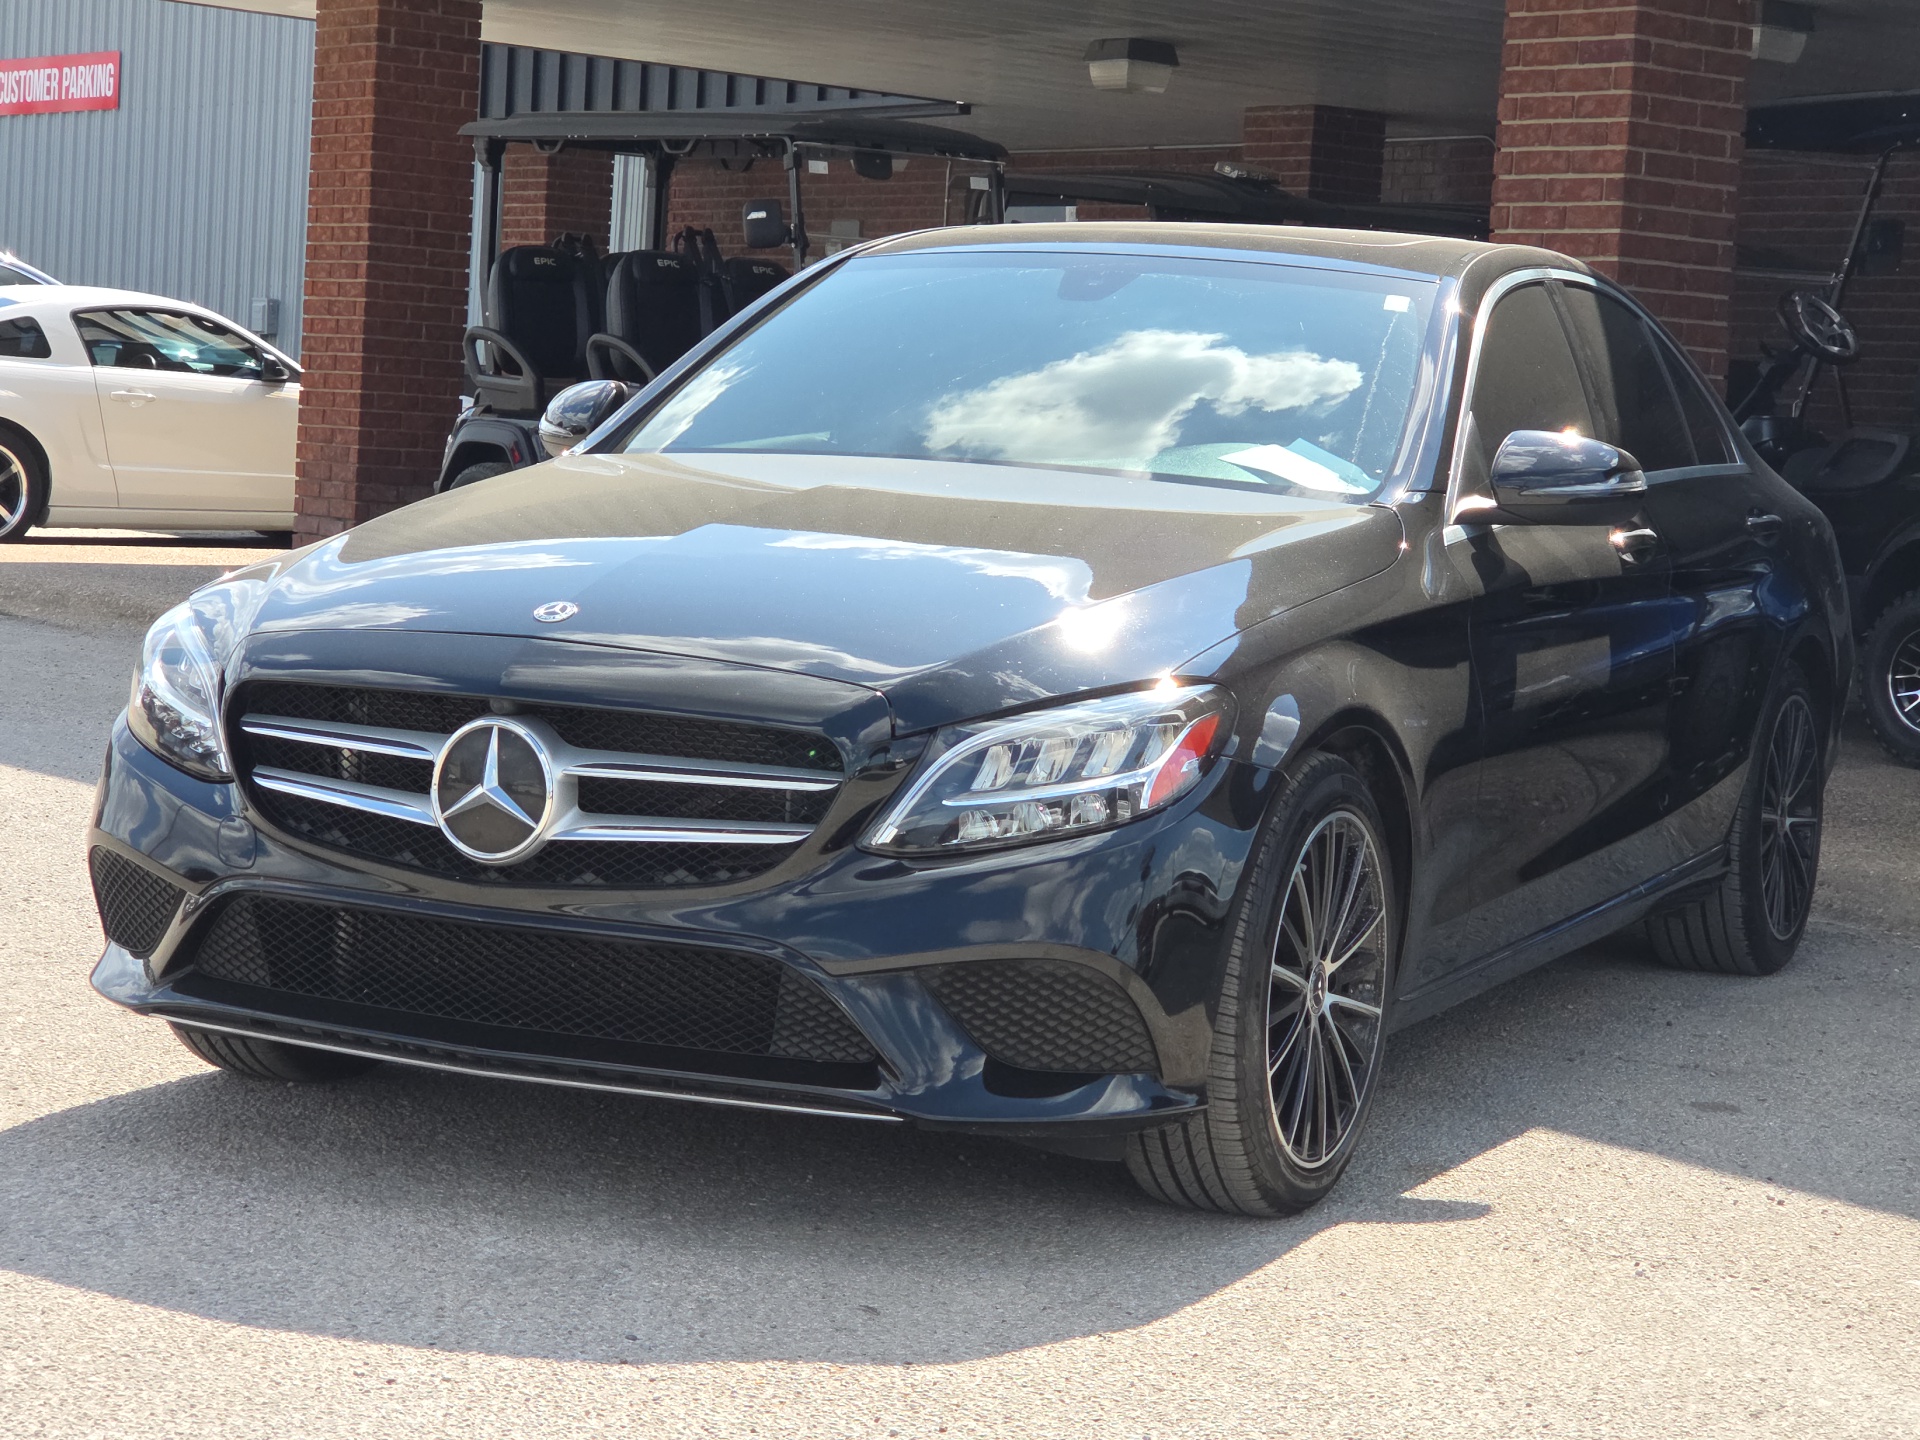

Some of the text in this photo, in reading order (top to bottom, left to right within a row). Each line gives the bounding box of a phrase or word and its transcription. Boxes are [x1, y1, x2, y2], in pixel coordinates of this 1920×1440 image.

[0, 63, 114, 104] CUSTOMER PARKING
[533, 257, 557, 266] EPIC
[656, 258, 680, 268] EPIC
[752, 265, 775, 275] EPIC
